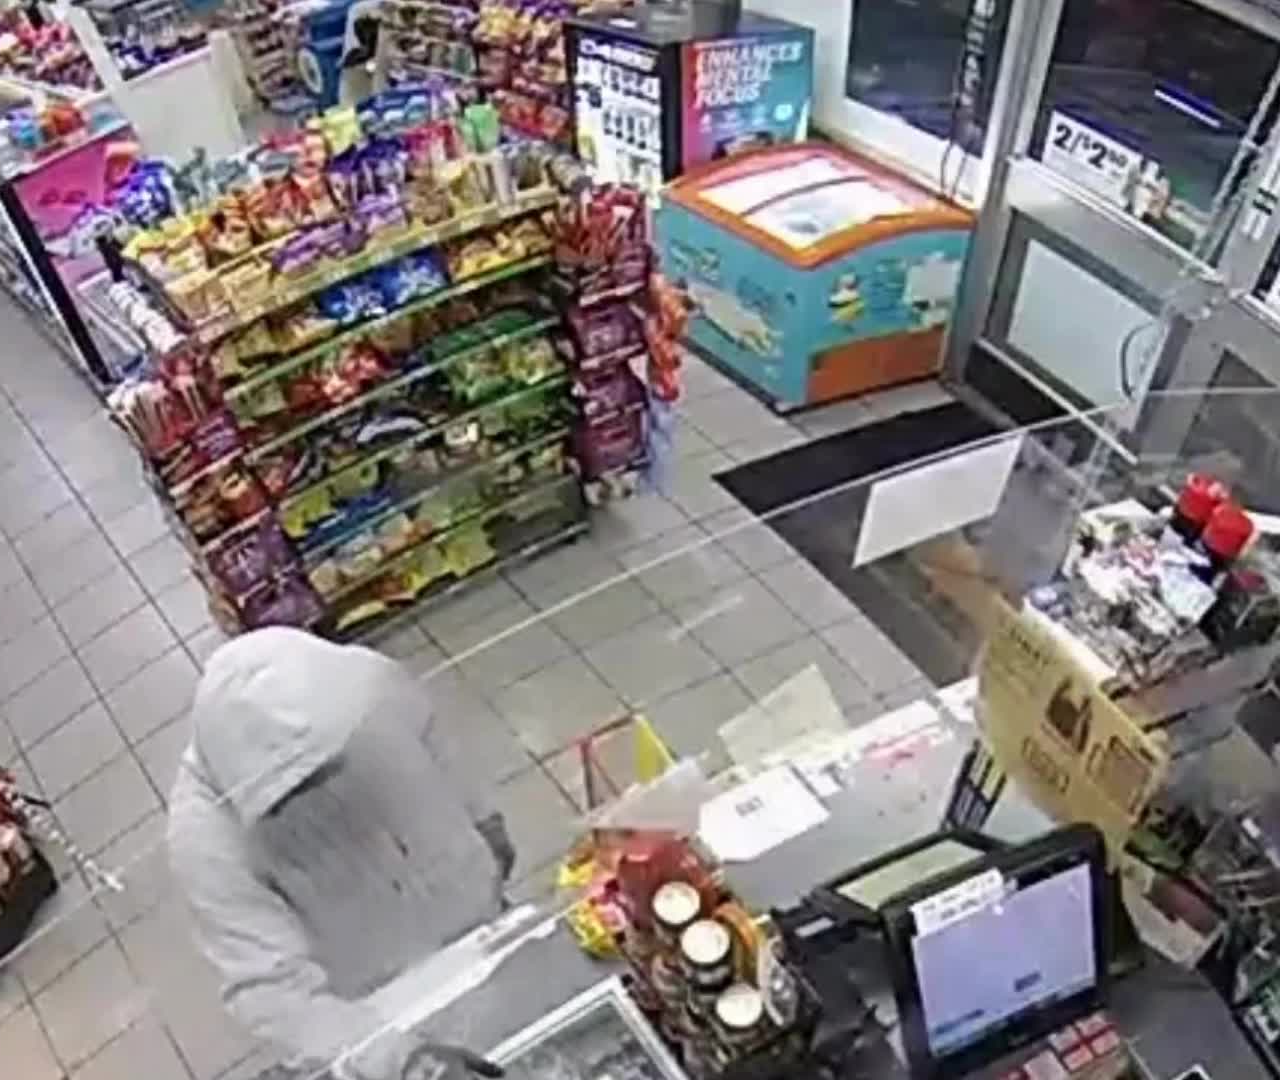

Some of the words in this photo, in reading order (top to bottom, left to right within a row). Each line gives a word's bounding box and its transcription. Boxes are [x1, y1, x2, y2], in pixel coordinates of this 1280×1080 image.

[696, 42, 803, 76] ENHANCES
[696, 62, 770, 91] MENTAL
[694, 82, 760, 108] FOCUS
